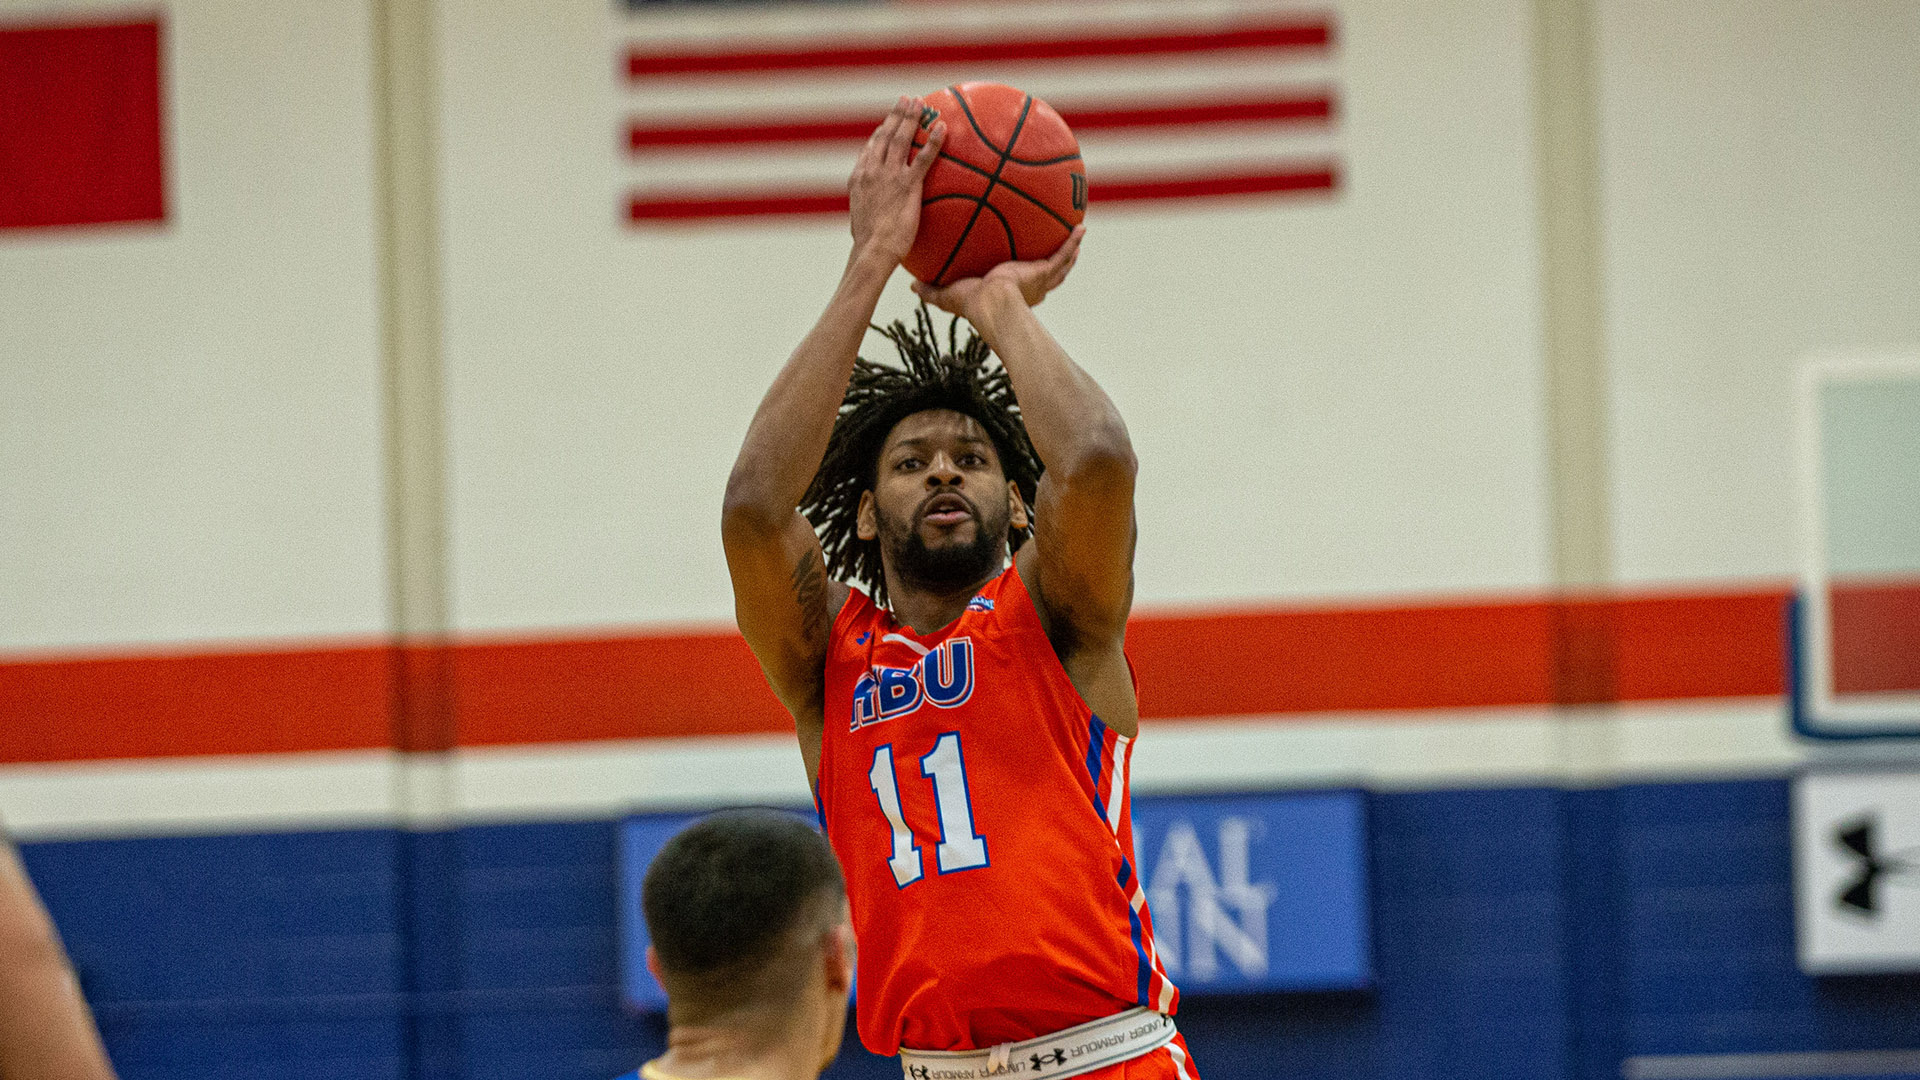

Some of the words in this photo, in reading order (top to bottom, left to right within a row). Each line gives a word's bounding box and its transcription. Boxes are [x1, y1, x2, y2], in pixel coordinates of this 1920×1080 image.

[868, 730, 990, 890] 11
[1129, 1019, 1161, 1039] UNDER
[1070, 1032, 1125, 1057] ARMOUR
[931, 1069, 975, 1080] ARMOUR
